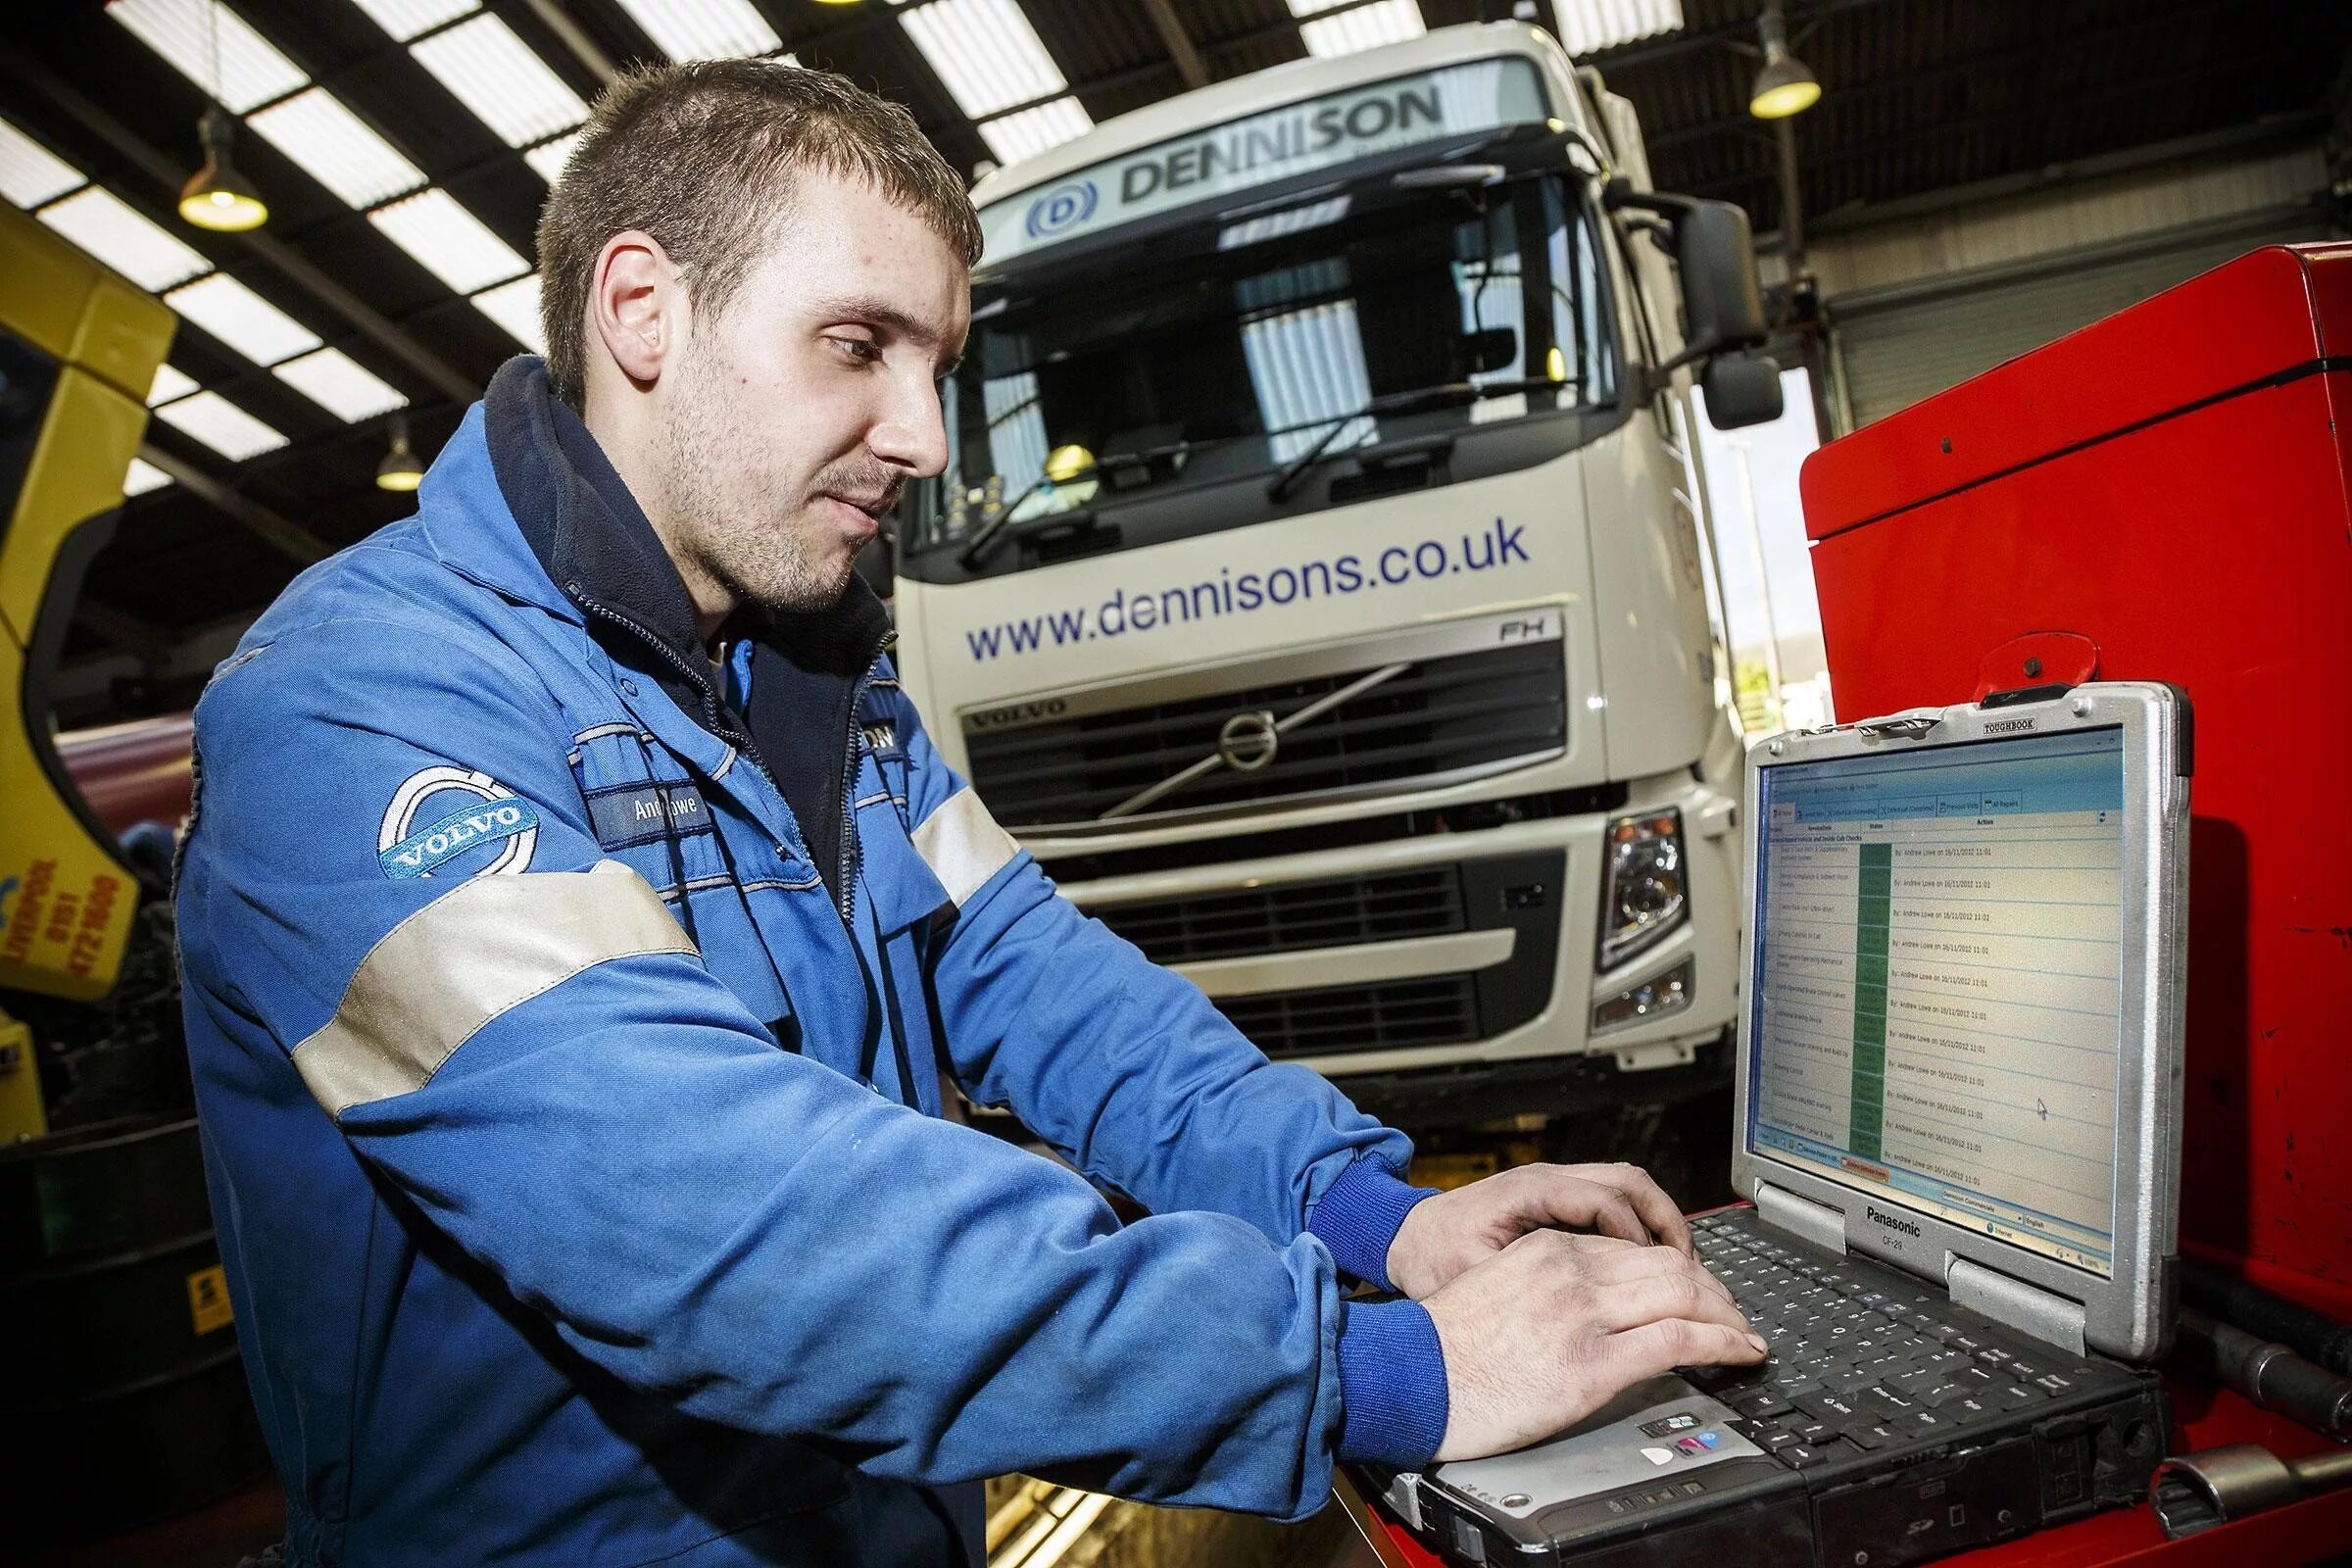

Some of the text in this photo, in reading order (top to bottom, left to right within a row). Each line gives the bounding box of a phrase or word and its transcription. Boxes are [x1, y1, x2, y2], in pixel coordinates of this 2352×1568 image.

[1120, 85, 1443, 205] DENNISON
[966, 516, 1530, 662] www.dennisons.co.uk
[1499, 616, 1545, 642] FH
[969, 697, 1066, 726] VOLVO
[1984, 719, 2034, 733] TOUGHBOOK
[394, 807, 521, 866] VOLVO
[1922, 848, 1936, 857] Lowe
[1921, 909, 1934, 918] Lowe
[1920, 941, 1933, 950] Lowe
[1919, 971, 1932, 981] Lowe
[1918, 1003, 1931, 1012] Lowe
[1917, 1034, 1930, 1045] Lowe
[1915, 1064, 1929, 1075] Lowe
[1914, 1096, 1928, 1107] Lowe
[1913, 1127, 1926, 1139] Lowe
[1911, 1157, 1925, 1169] Lowe
[1867, 1205, 1920, 1238] Panasonic
[1883, 1235, 1902, 1250] CF-29
